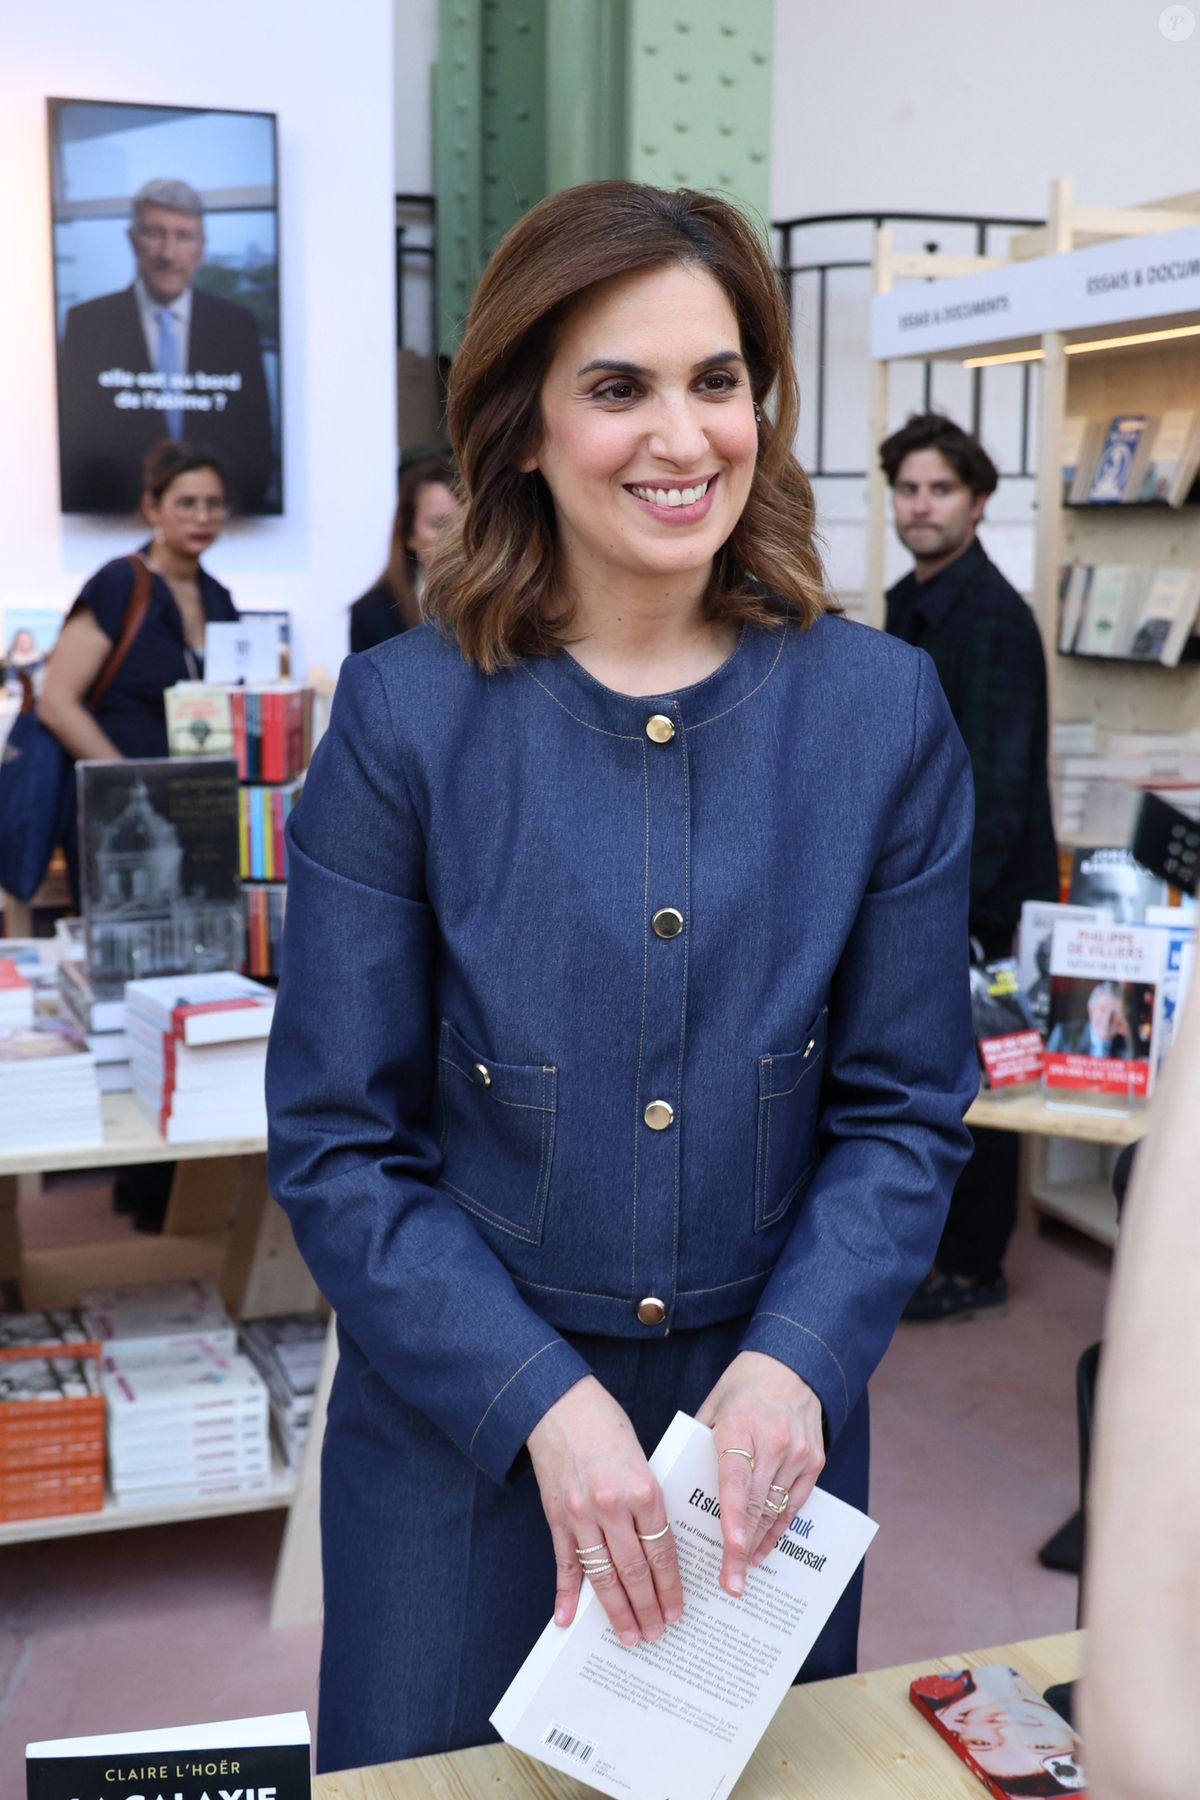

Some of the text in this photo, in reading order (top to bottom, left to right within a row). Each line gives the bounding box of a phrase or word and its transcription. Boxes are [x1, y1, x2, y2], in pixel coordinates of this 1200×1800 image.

[1086, 270, 1129, 295] ESSAIS
[1133, 268, 1142, 288] &
[900, 310, 929, 331] ESSAIS
[944, 294, 1010, 323] DOCUMENTS
[98, 368, 242, 391] elle est au bord
[114, 389, 141, 409] de
[688, 1488, 702, 1509] Et
[701, 1496, 717, 1515] si
[773, 1534, 828, 1573] s'inversait
[105, 1759, 241, 1782] CLAIRE L'HOËR
